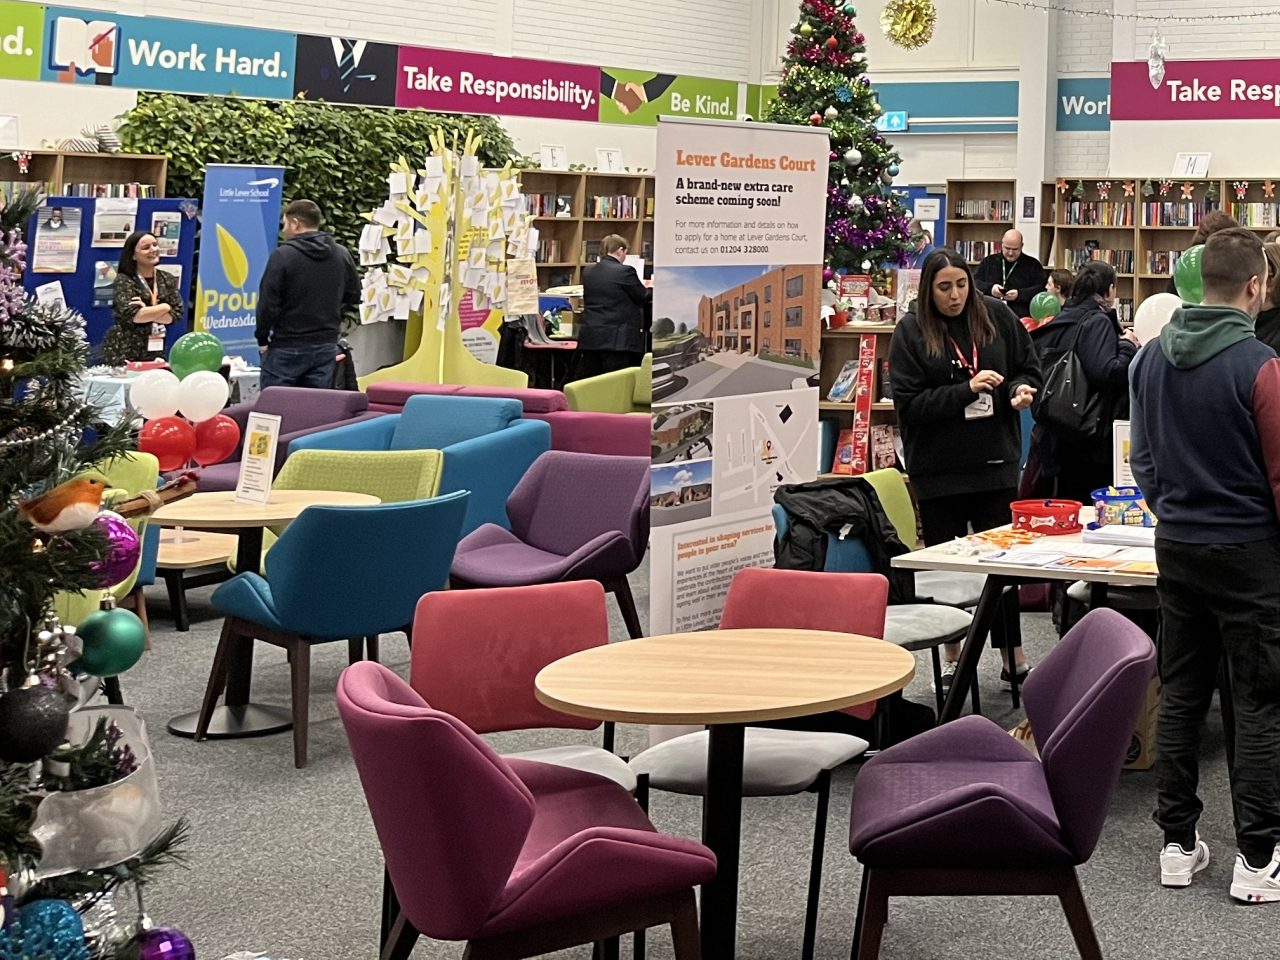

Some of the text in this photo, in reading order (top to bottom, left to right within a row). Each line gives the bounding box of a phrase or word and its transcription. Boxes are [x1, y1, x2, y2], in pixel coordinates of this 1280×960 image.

[128, 38, 288, 79] Work Hard.
[403, 66, 596, 110] Take Responsibility.
[1166, 79, 1222, 103] Take
[670, 93, 734, 117] Be Kind.
[1062, 92, 1110, 116] Wor
[676, 149, 816, 172] Lever Gardens Court
[250, 188, 270, 197] School
[676, 178, 793, 193] A brand-new extra care
[676, 193, 781, 209] scheme coming soon!
[675, 220, 686, 228] For
[706, 221, 742, 229] information
[743, 221, 756, 229] and
[757, 221, 775, 229] details
[675, 233, 683, 241] to
[684, 234, 702, 242] apply
[703, 233, 712, 241] for
[720, 233, 737, 241] home
[738, 233, 745, 241] at
[747, 233, 764, 241] Lever
[765, 233, 790, 241] Gardens
[791, 233, 808, 242] Court,
[675, 246, 699, 254] contact
[720, 245, 742, 254] 01204
[203, 289, 257, 312] Prou
[200, 313, 257, 329] Wednesda
